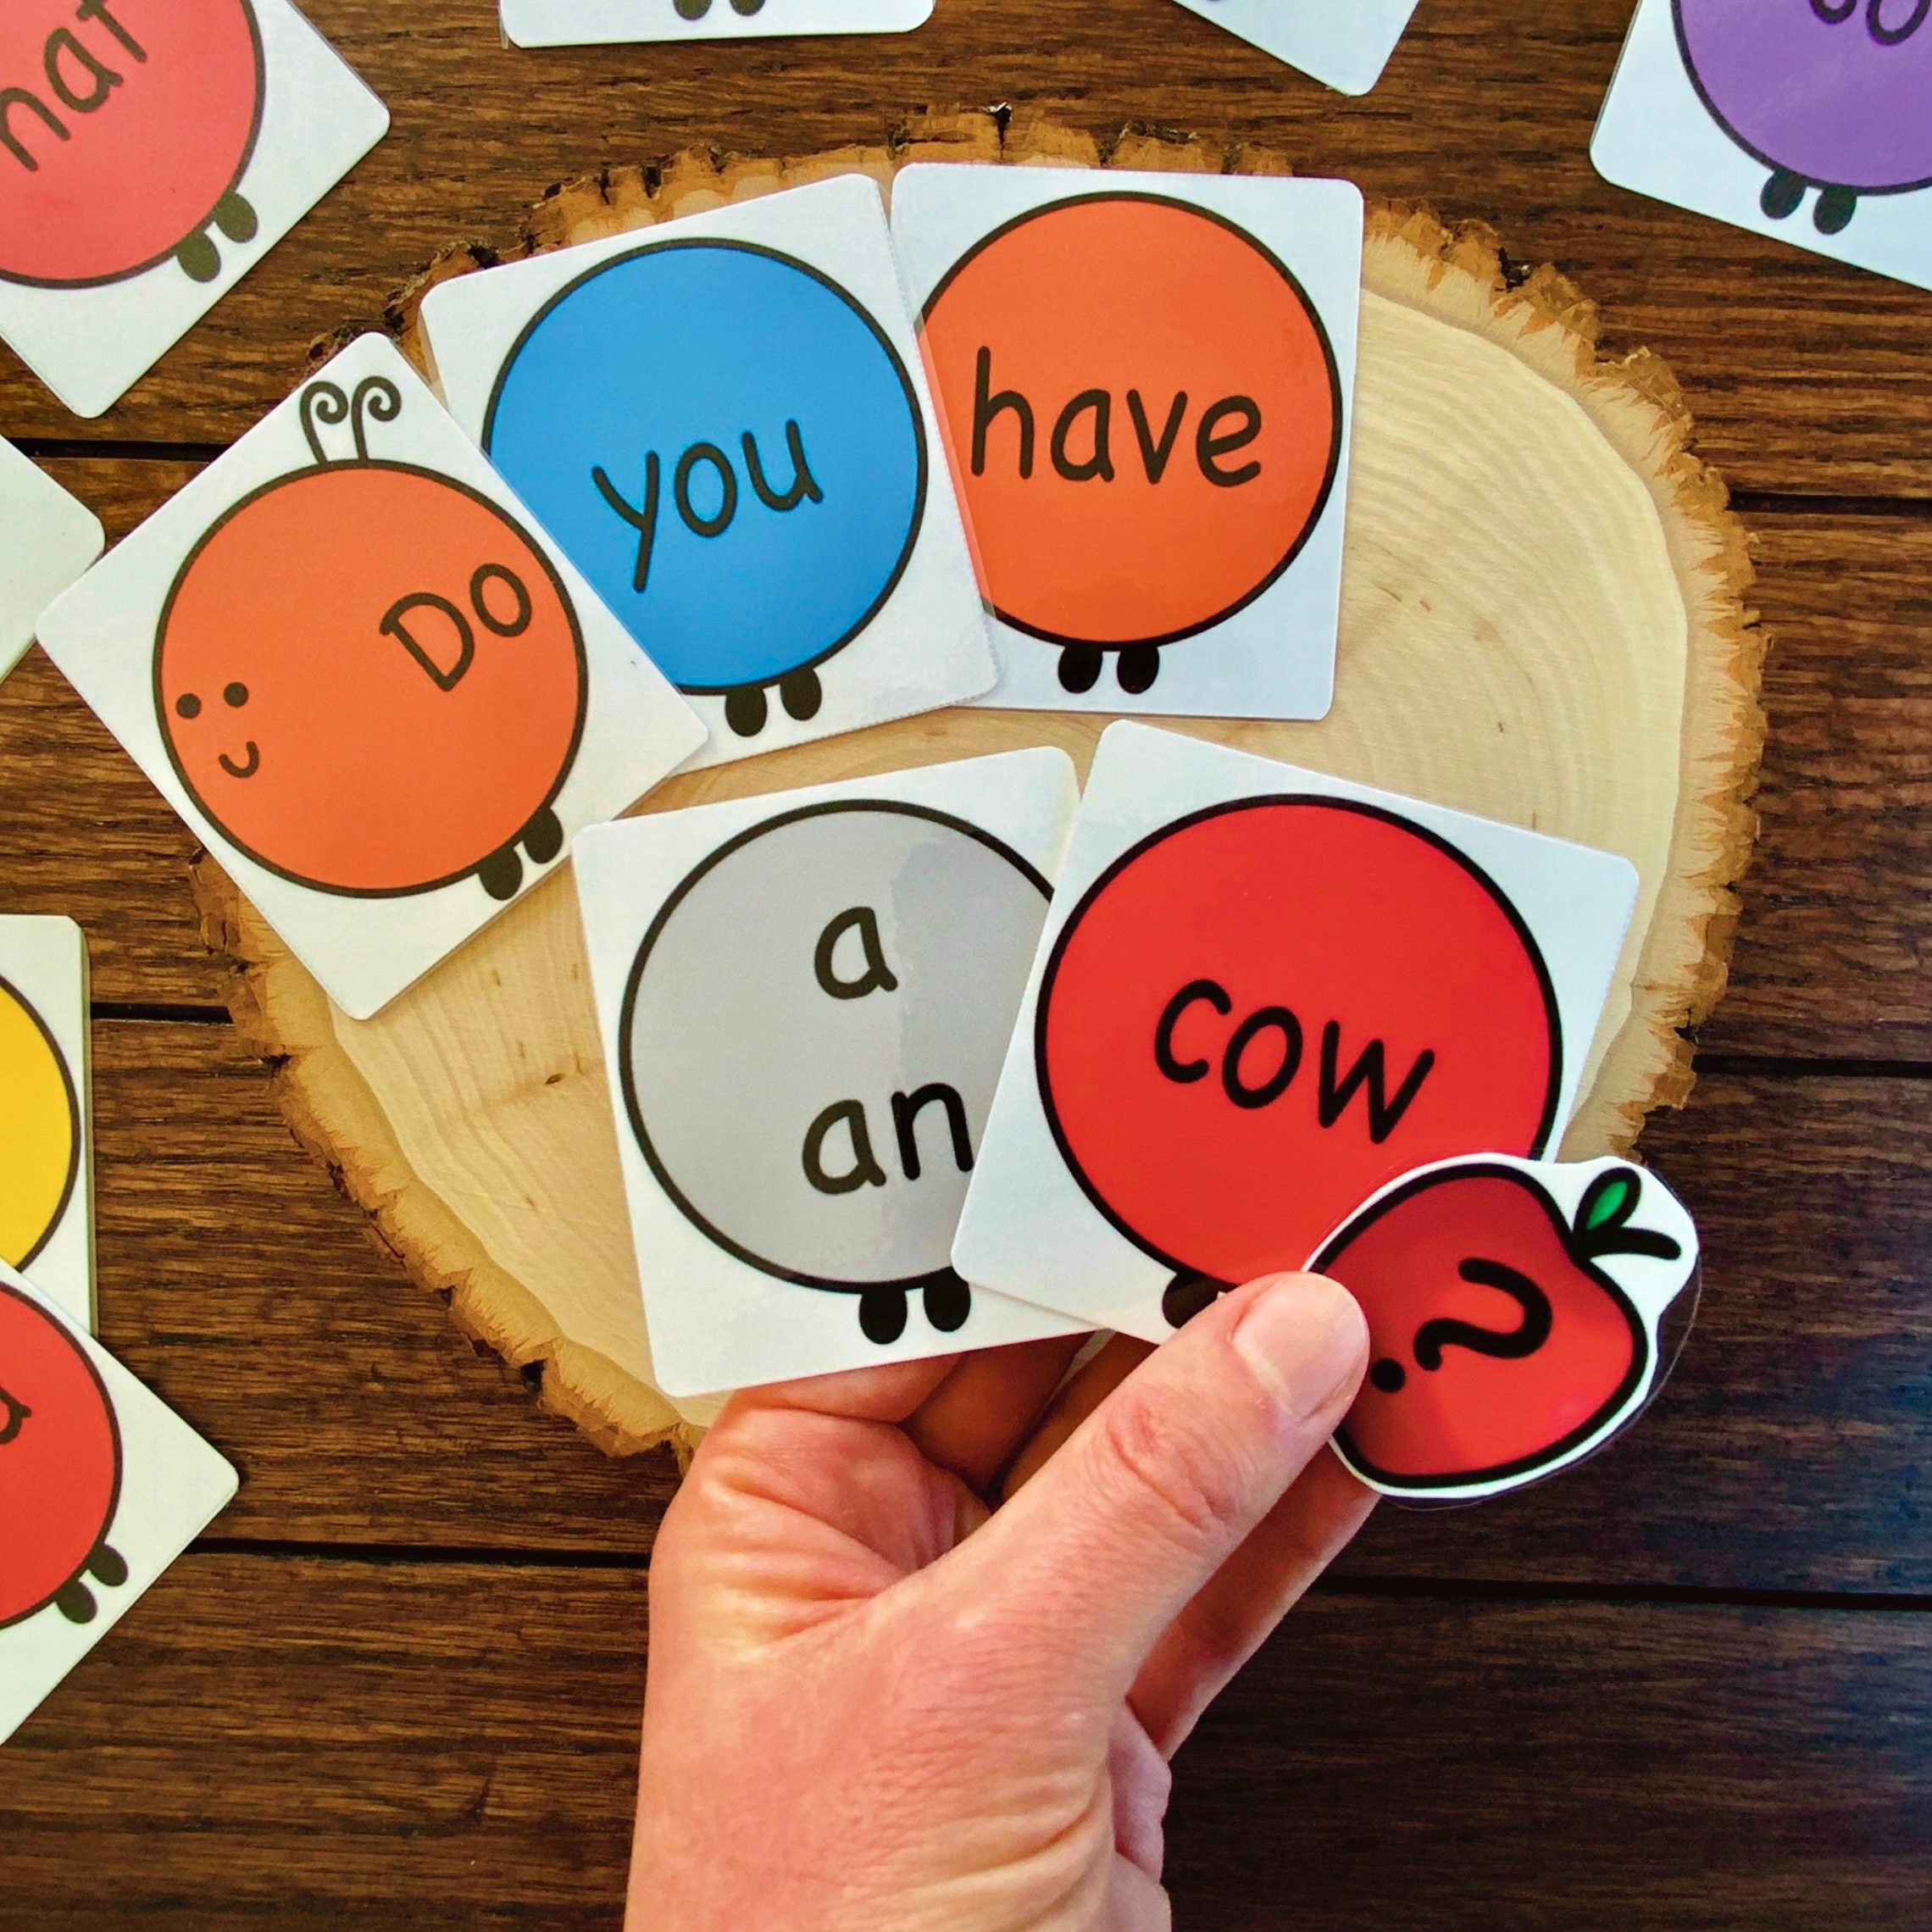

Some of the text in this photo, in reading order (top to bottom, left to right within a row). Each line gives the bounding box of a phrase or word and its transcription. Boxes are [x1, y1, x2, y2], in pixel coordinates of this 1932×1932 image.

[970, 345, 1262, 488] have
[591, 419, 824, 593] you
[379, 563, 533, 692] Do
[813, 906, 899, 1001] a
[1154, 979, 1435, 1145] cow
[802, 1082, 974, 1196] an
[1369, 1257, 1553, 1395] ?
